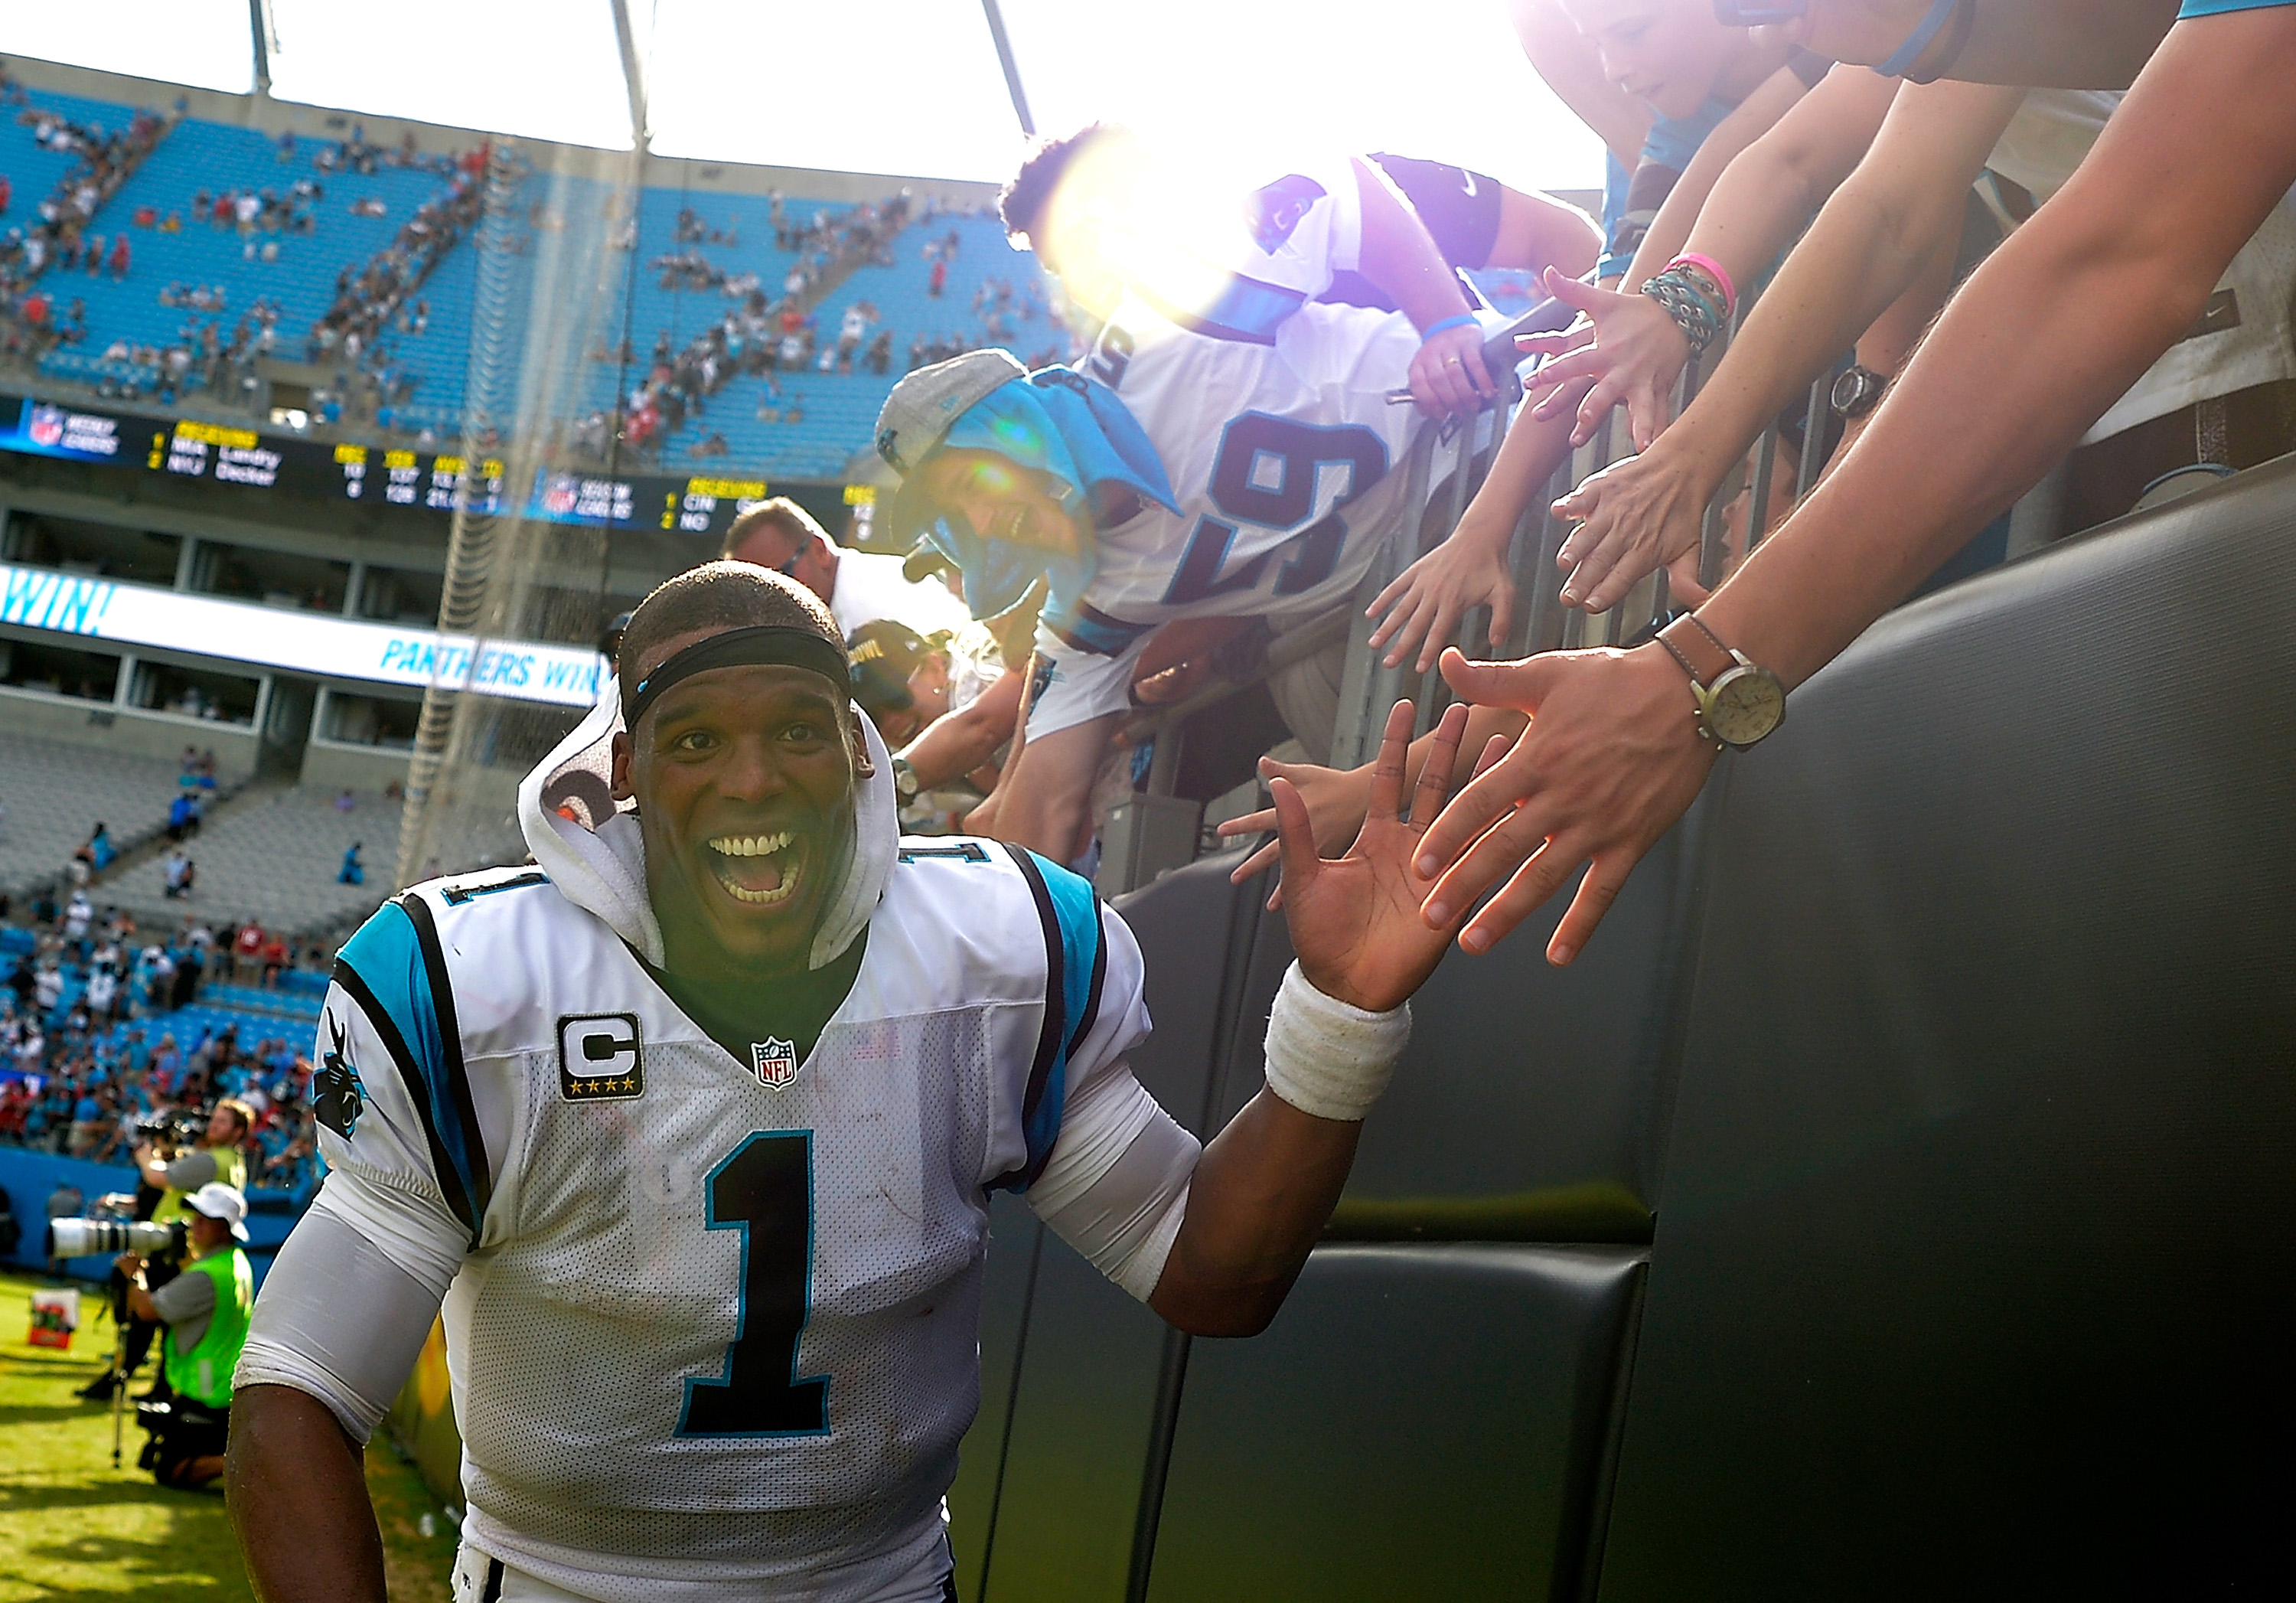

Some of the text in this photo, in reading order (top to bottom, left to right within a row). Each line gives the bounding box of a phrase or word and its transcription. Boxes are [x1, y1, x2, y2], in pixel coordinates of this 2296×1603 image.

[679, 511, 710, 532] NO
[2, 567, 117, 635] WIN!
[380, 638, 536, 687] PANTHERS
[563, 1017, 636, 1078] C
[762, 1059, 792, 1083] NFL
[672, 1129, 831, 1439] 1
